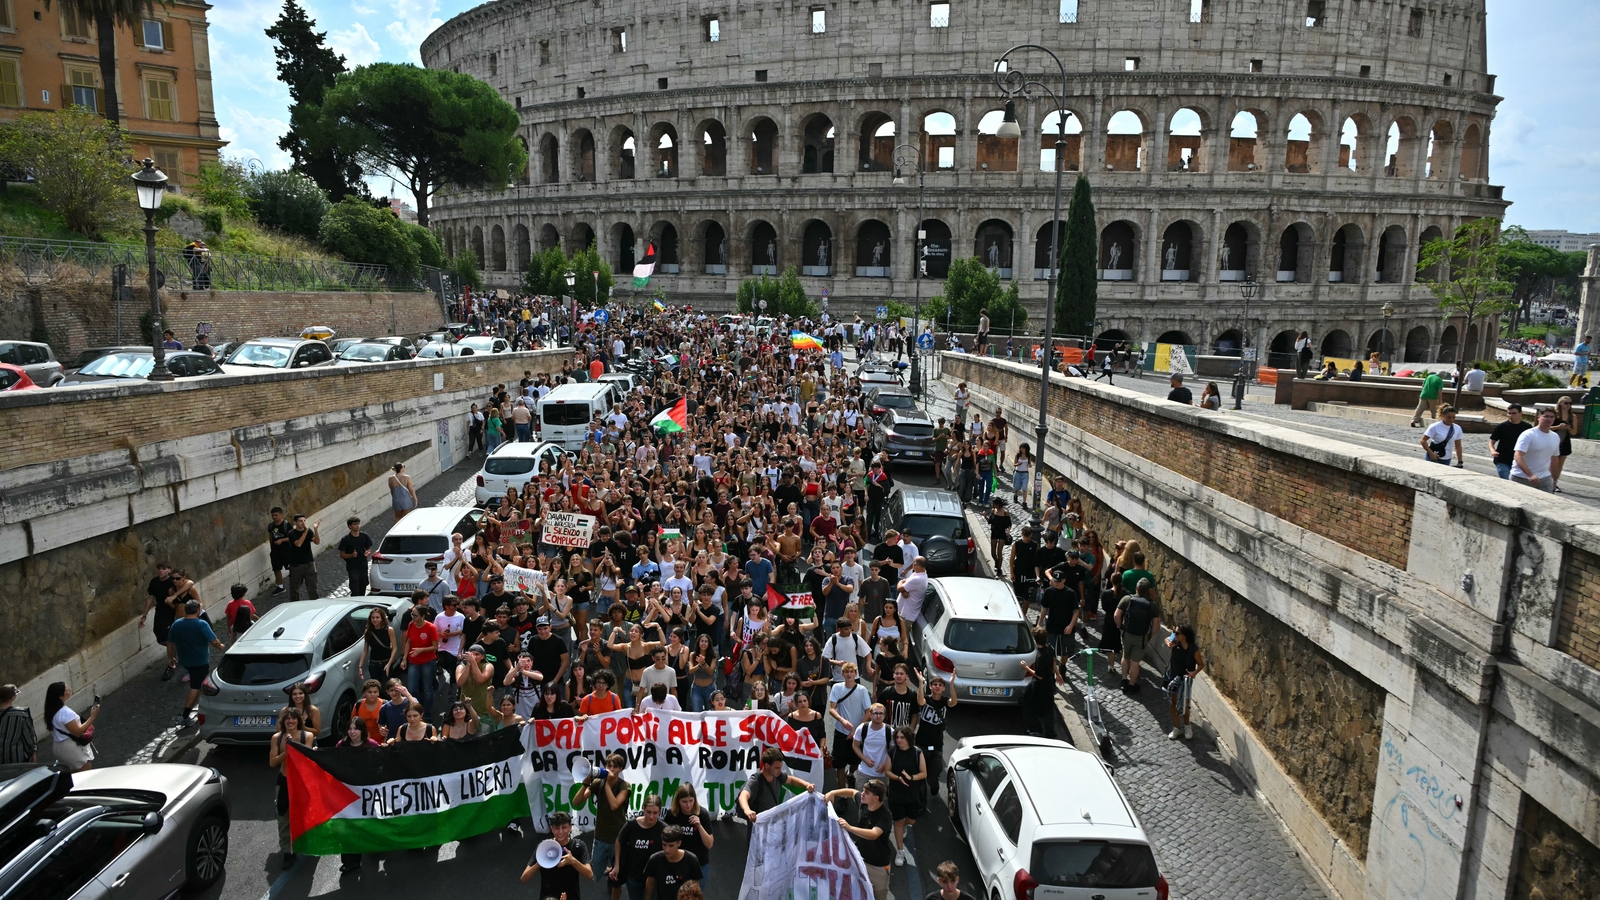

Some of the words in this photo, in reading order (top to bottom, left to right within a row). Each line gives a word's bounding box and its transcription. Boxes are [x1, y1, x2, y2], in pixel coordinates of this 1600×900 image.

[547, 513, 574, 522] DAVANTI
[790, 594, 814, 606] FREE
[668, 719, 728, 748] ALLE
[739, 714, 819, 759] SCUOLE
[531, 750, 558, 772] DA
[666, 746, 682, 766] A
[698, 746, 760, 772] ROMA
[362, 778, 450, 816] PALESTINA
[460, 761, 512, 800] LIBERA
